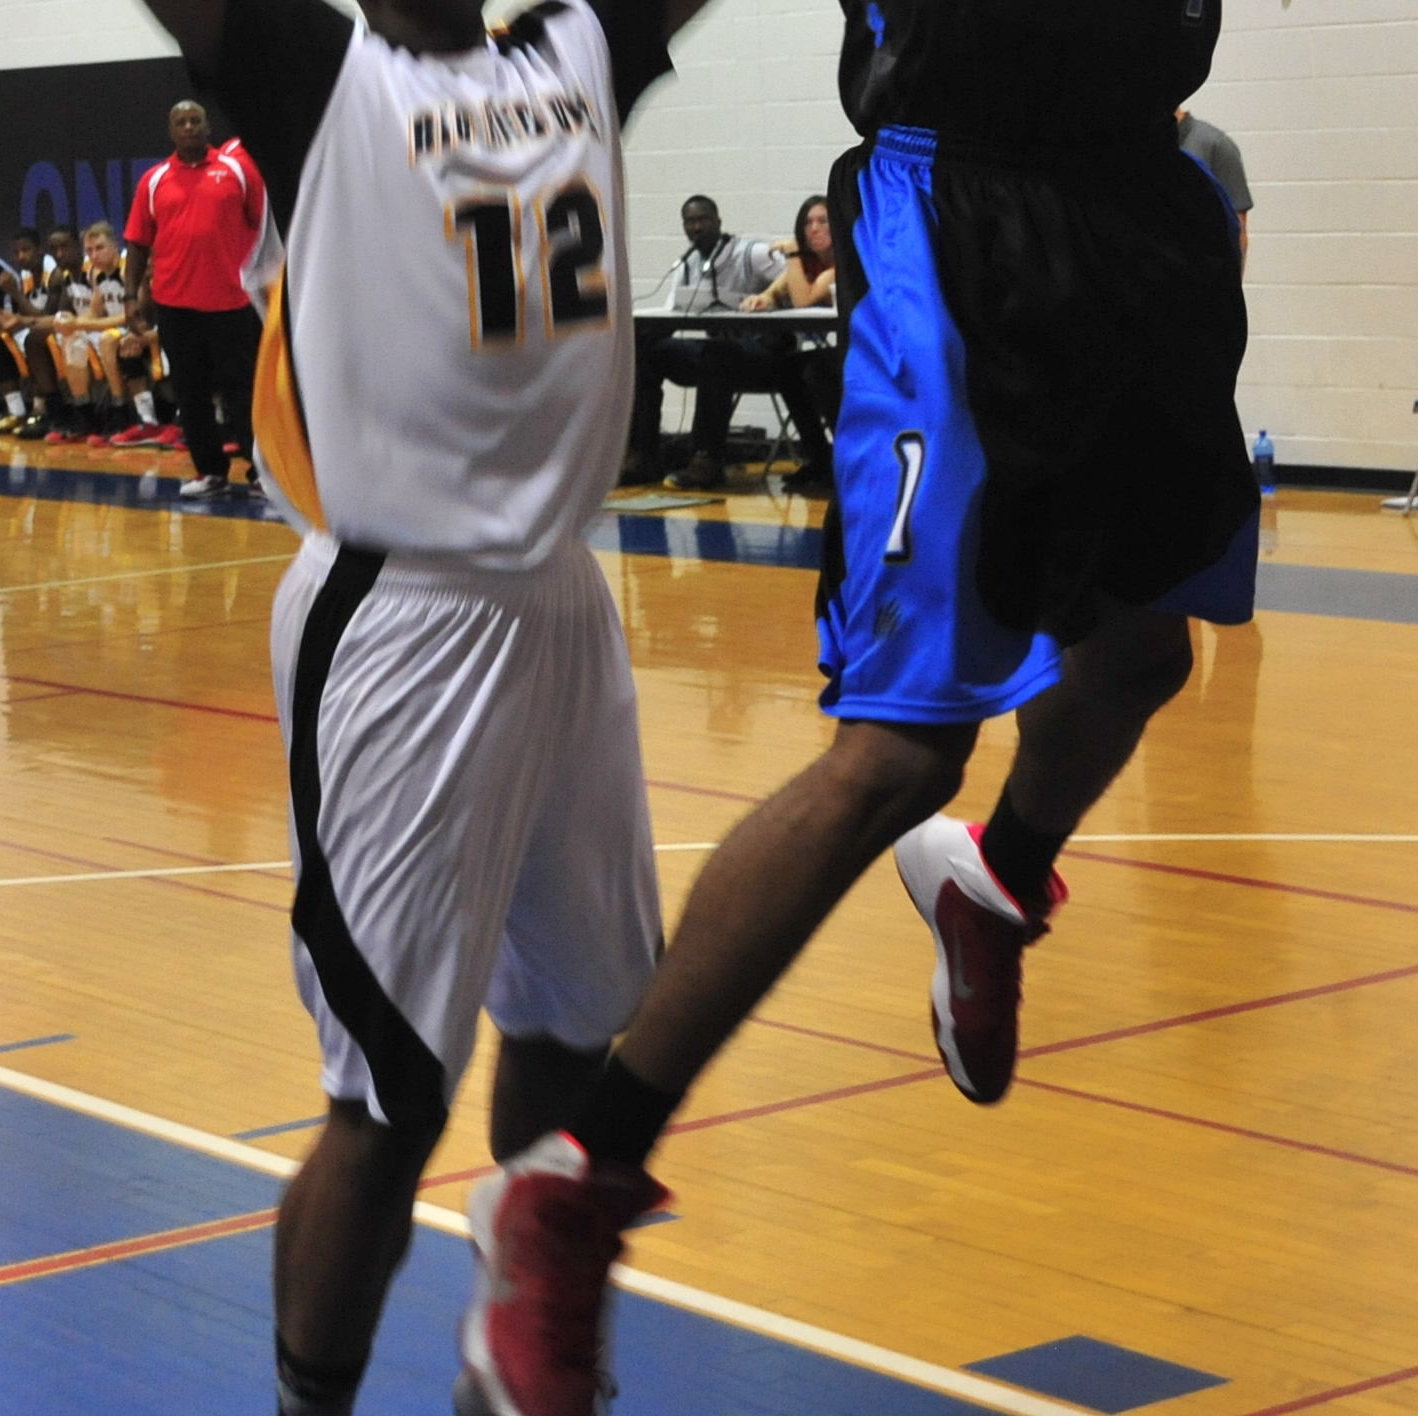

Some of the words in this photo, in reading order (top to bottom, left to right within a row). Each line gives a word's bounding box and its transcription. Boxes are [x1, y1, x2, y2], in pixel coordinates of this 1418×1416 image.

[20, 158, 173, 249] ON
[447, 179, 609, 346] 12
[886, 434, 924, 561] 1
